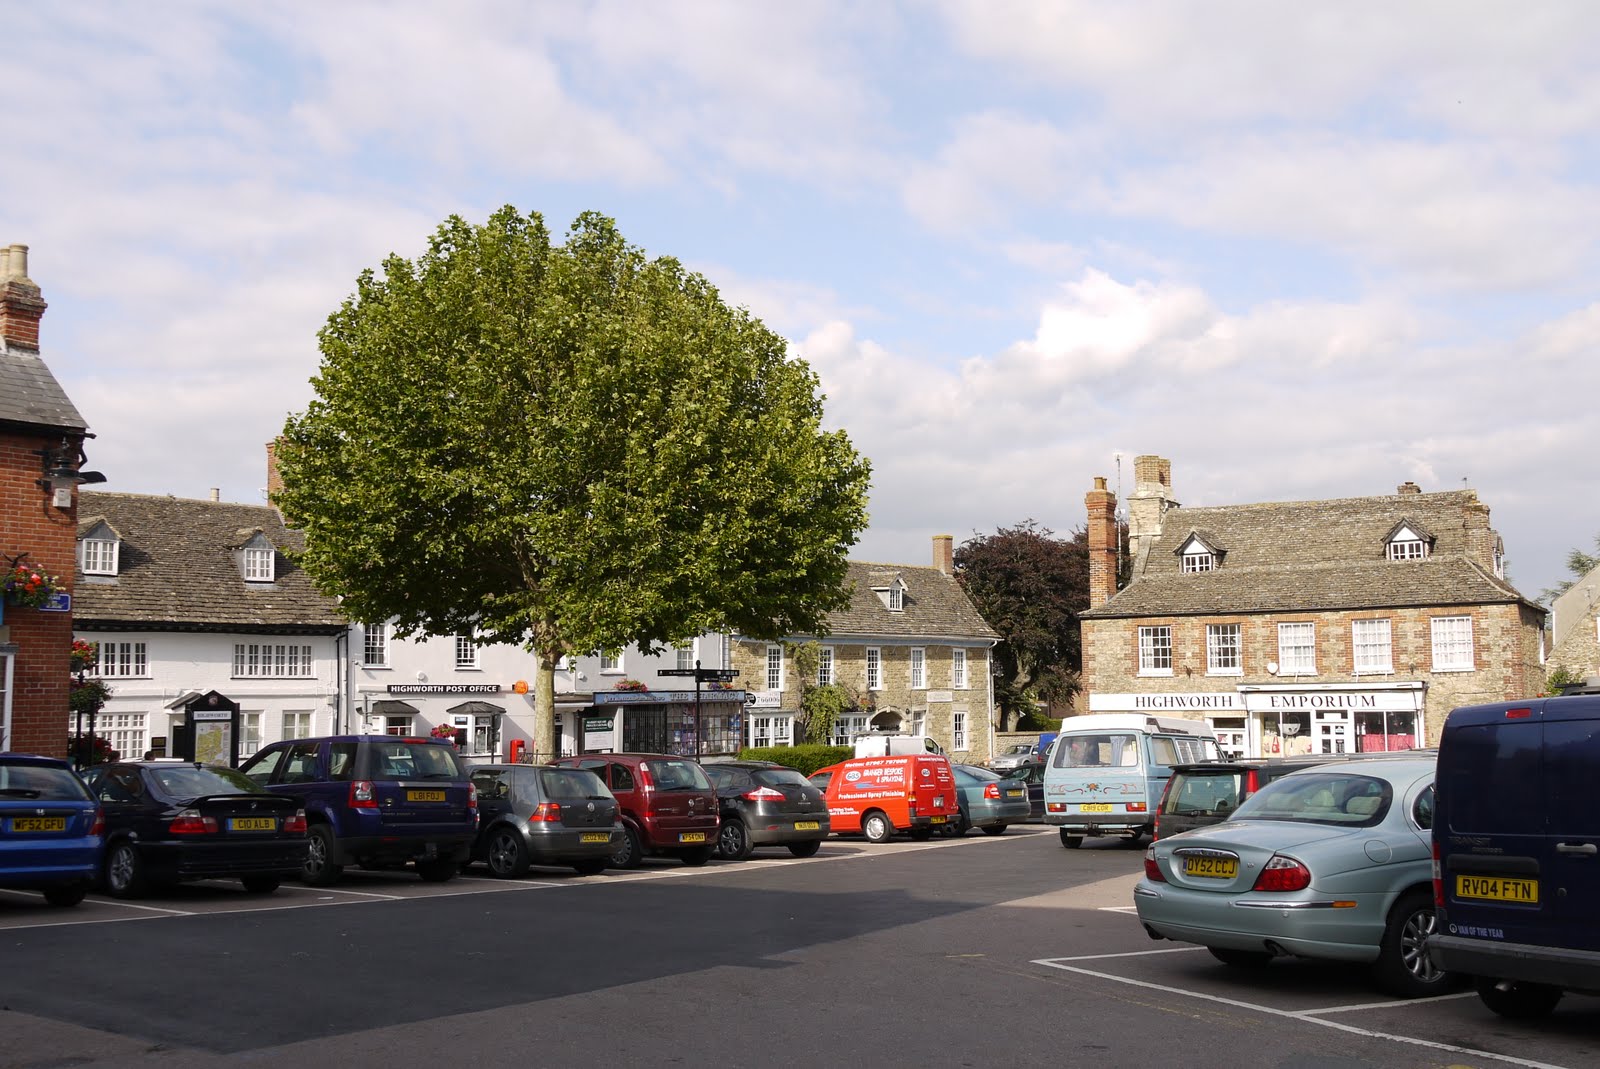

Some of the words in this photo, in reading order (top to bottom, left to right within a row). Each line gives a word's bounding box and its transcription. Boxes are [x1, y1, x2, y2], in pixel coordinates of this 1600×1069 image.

[1135, 696, 1232, 707] HIGHWORTH
[1271, 695, 1376, 707] EMPORIUM
[838, 791, 868, 799] Professional
[868, 791, 882, 799] Spray
[15, 820, 41, 830] WF52
[44, 819, 65, 830] GFU
[1215, 860, 1236, 874] CCJ
[1462, 879, 1498, 896] RV04
[1502, 882, 1531, 899] FTN
[1458, 926, 1469, 935] VAN
[1469, 927, 1476, 935] OF
[1476, 928, 1488, 937] THE
[1488, 929, 1504, 938] YEAR
